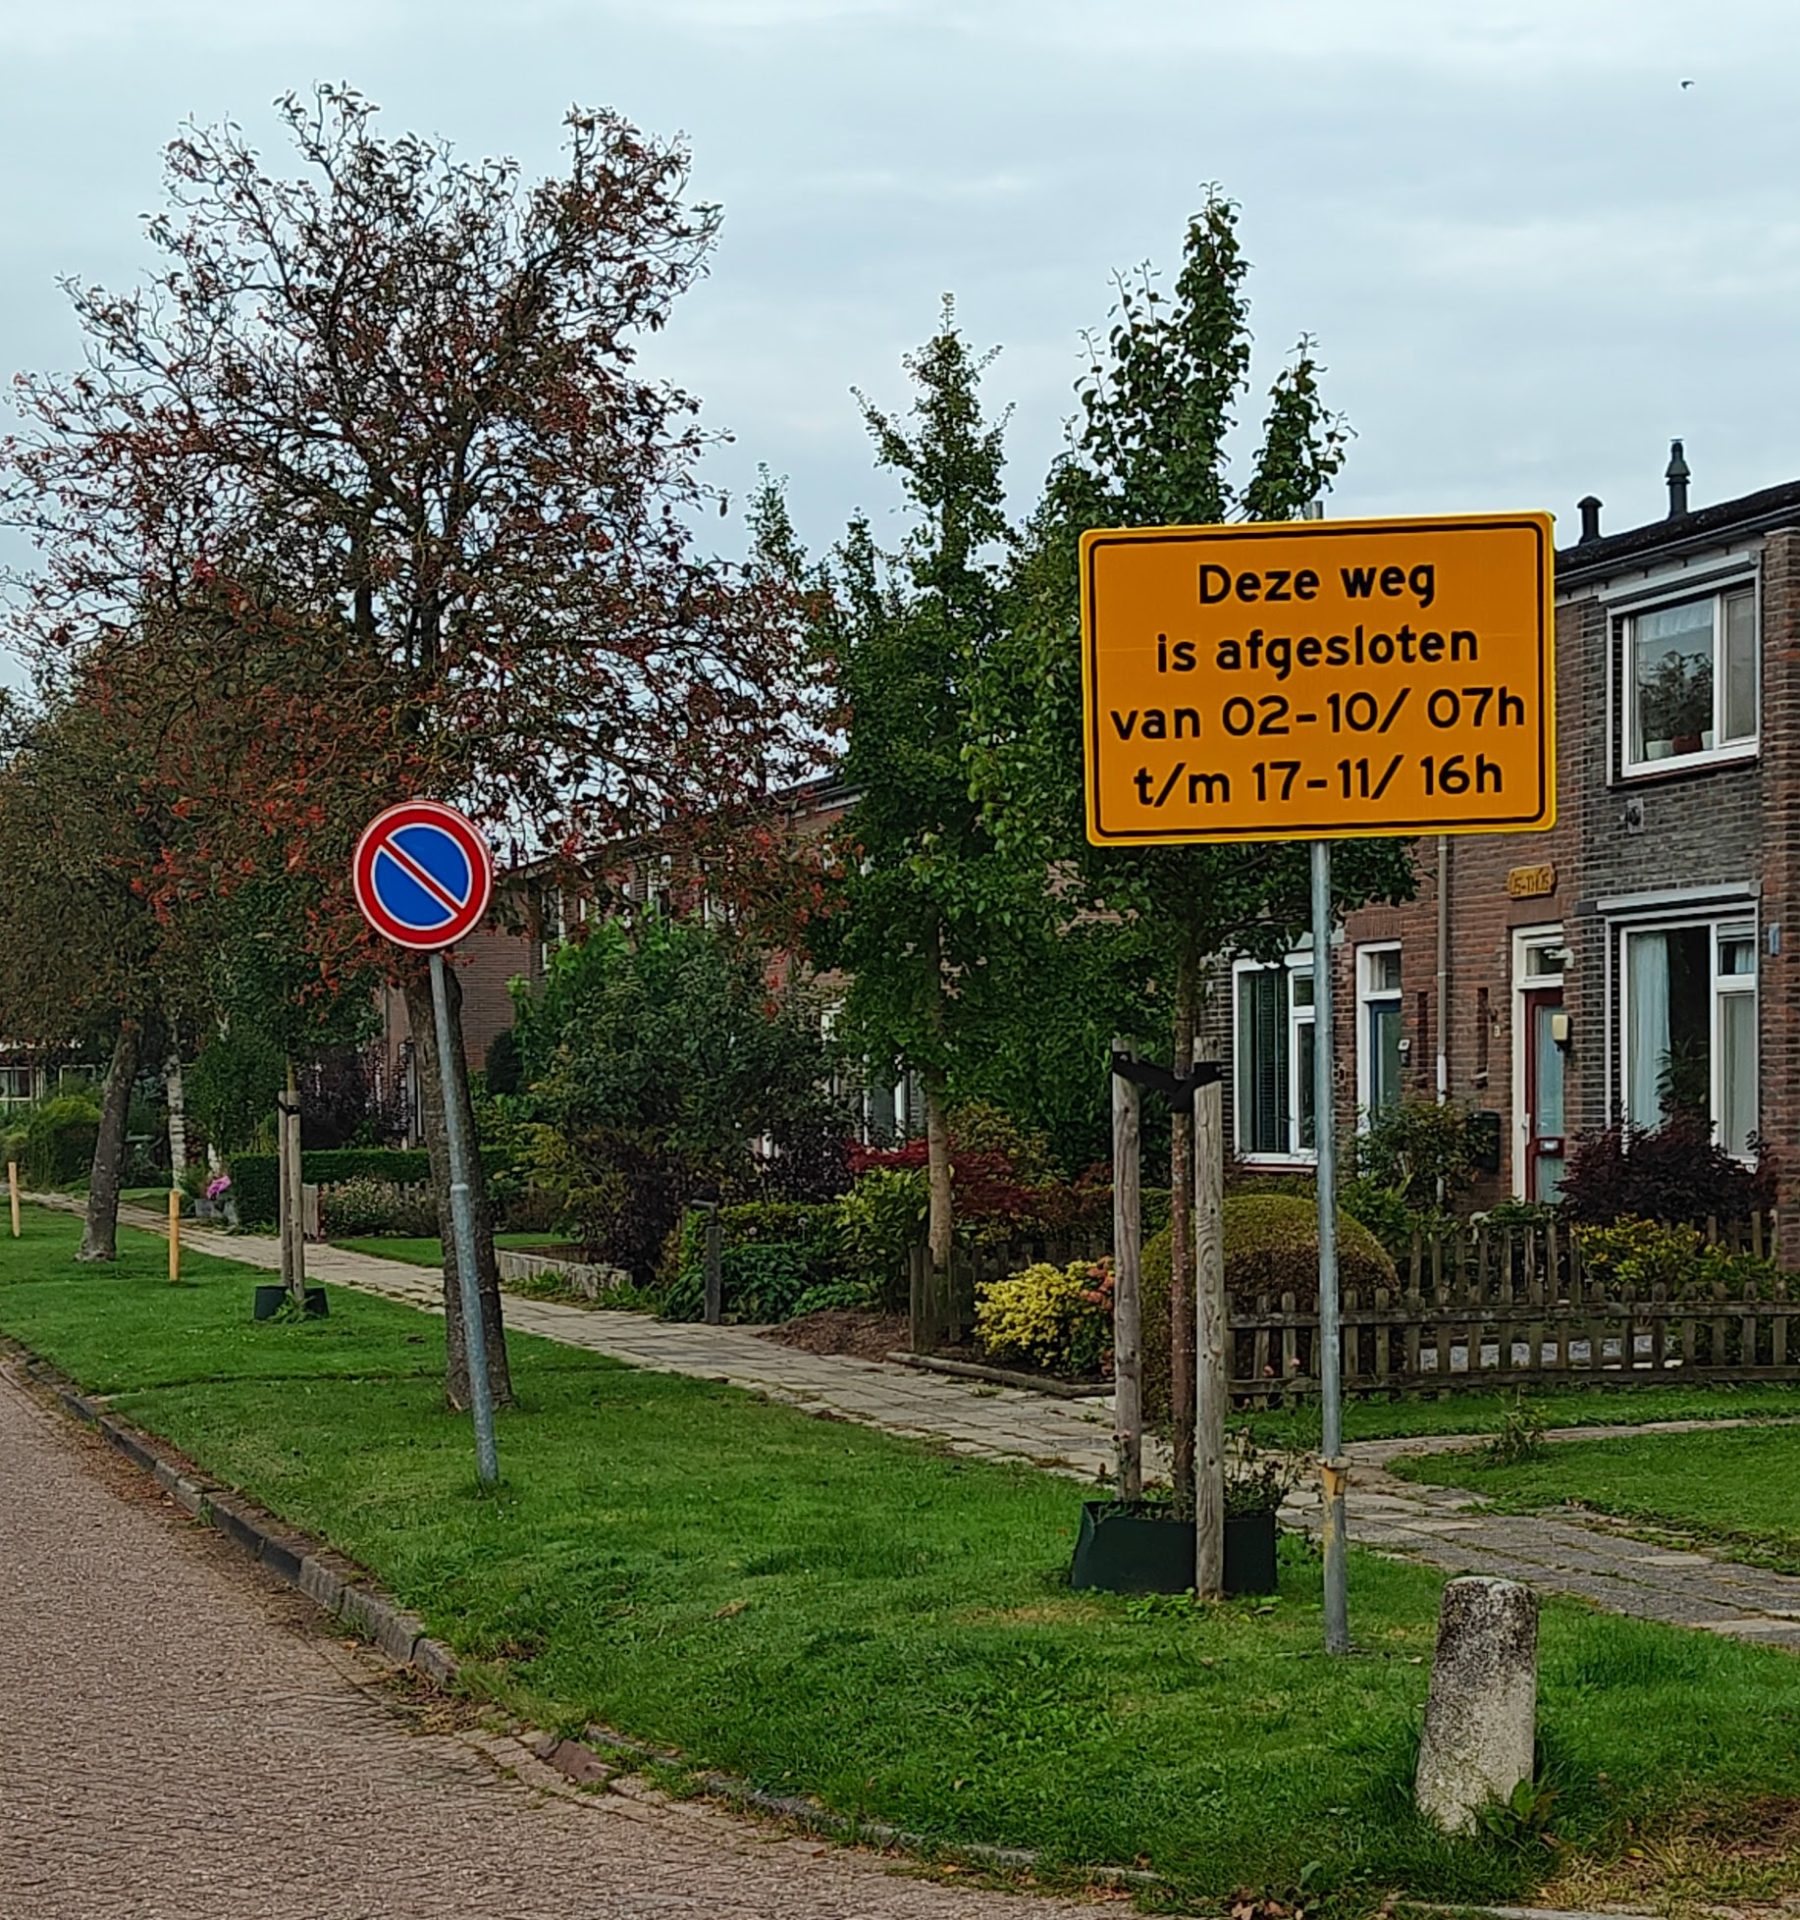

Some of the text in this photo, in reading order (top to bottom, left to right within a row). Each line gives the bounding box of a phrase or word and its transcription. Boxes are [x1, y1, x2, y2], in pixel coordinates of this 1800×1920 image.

[1200, 565, 1435, 608] Deze weg
[1158, 625, 1478, 680] is afgesloten
[1111, 708, 1201, 741] van
[1428, 687, 1525, 729] 07h
[1134, 763, 1230, 808] t/m
[1421, 754, 1503, 796] 16h
